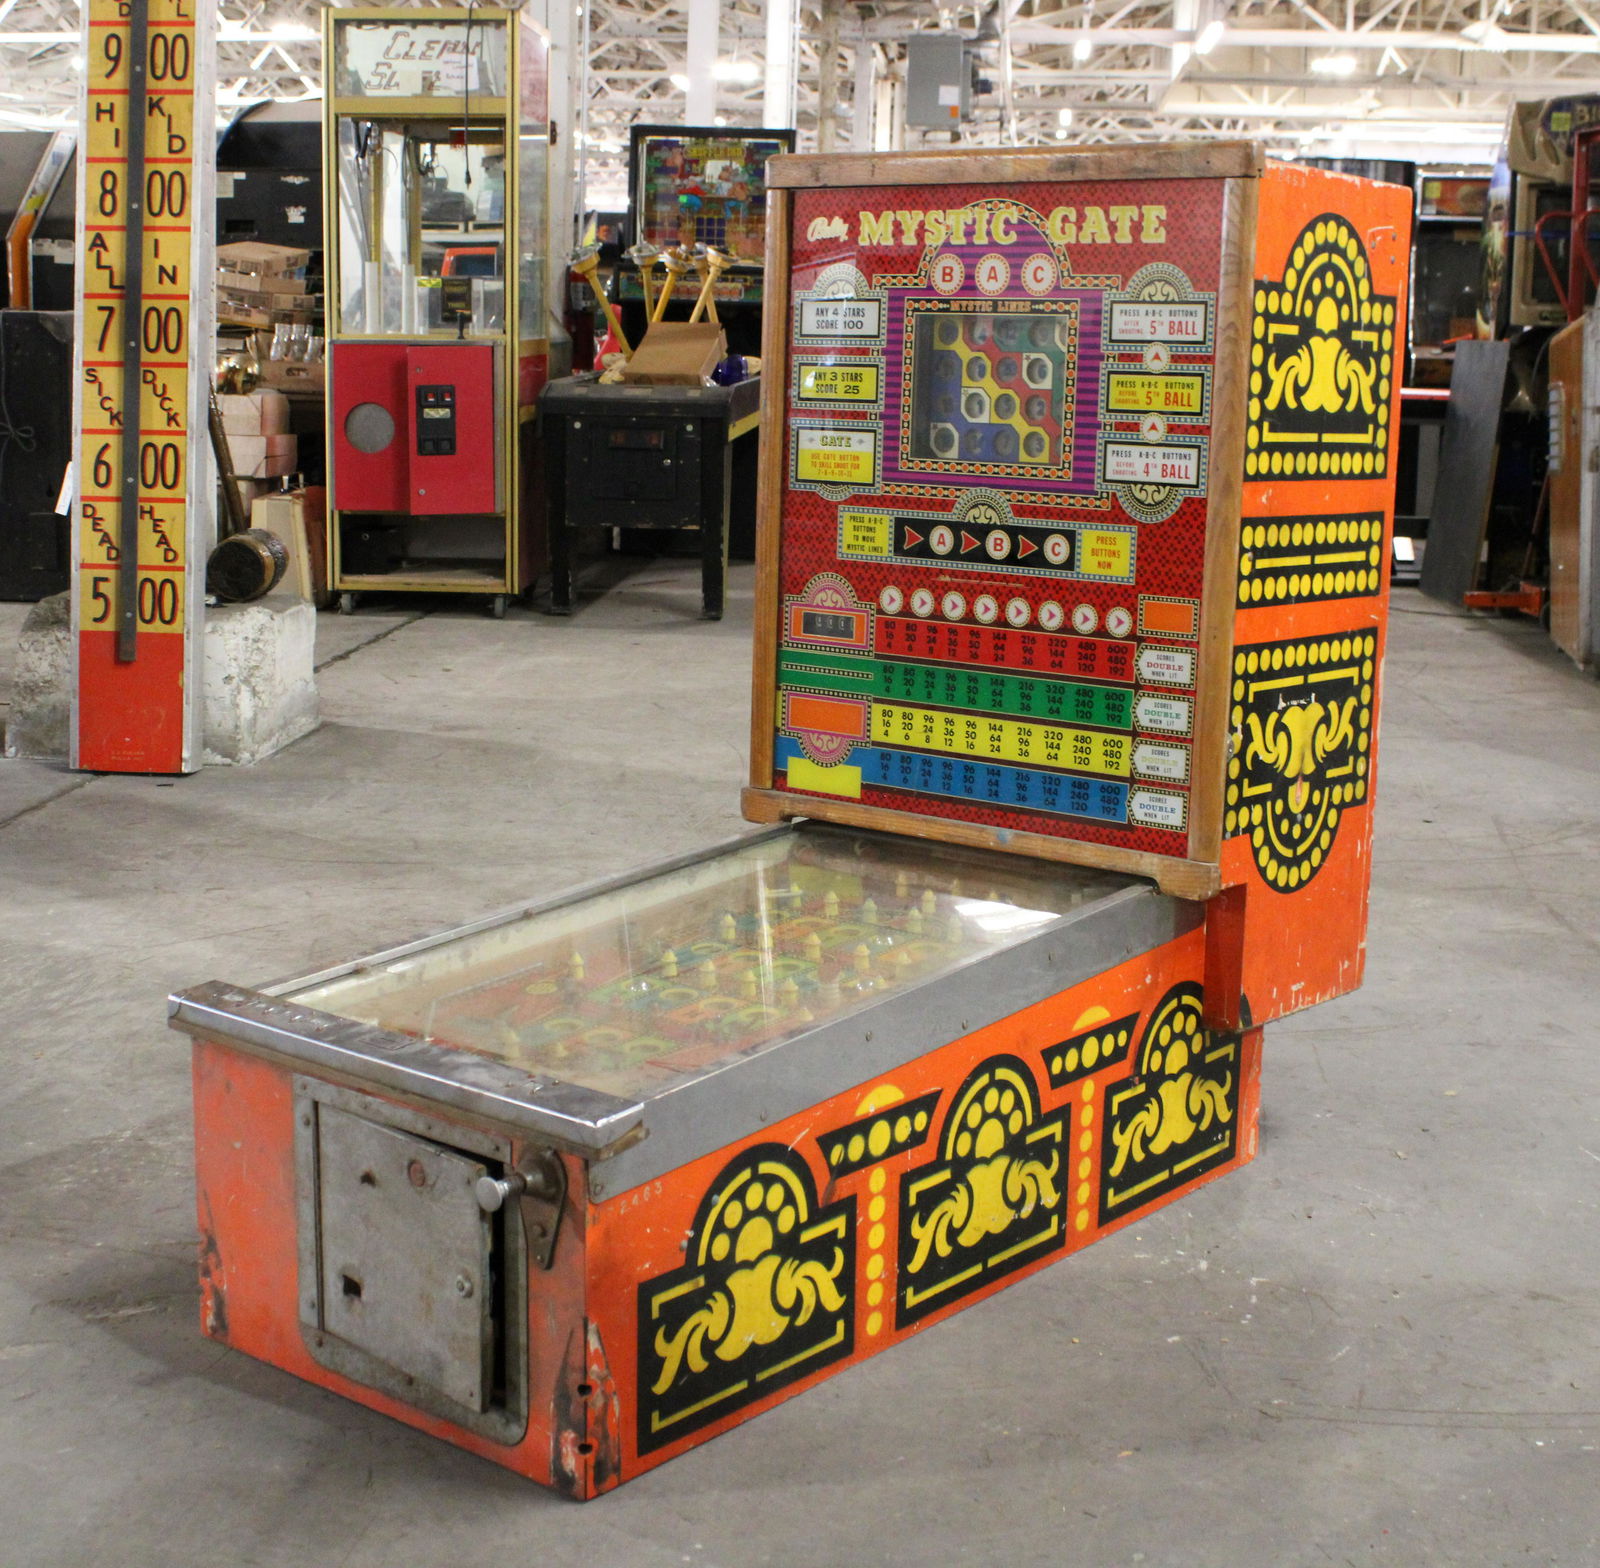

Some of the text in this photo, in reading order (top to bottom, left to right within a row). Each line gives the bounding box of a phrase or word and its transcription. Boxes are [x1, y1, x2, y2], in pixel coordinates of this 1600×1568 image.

[104, 33, 190, 81] 9 00
[95, 96, 187, 155] HI KID
[99, 170, 187, 219] 8 00
[858, 209, 1018, 246] MYSTIC
[1049, 205, 1167, 244] GATE
[88, 232, 179, 290] ALL IN
[941, 265, 1045, 284] B A C
[816, 308, 866, 318] ANY 4 STARS
[951, 301, 1032, 312] MYSTIC LINES
[97, 306, 184, 354] 7 00
[816, 321, 863, 330] SCORE 100
[1169, 321, 1197, 335] BALL
[814, 372, 863, 382] ANY 3 STARS
[816, 384, 860, 394] SCORE 25
[1117, 380, 1136, 389] PRESS
[1165, 382, 1194, 390] BUTTONS
[84, 368, 181, 428] SICK DUCK
[1164, 392, 1192, 407] BALL
[819, 435, 852, 448] GATE
[1112, 450, 1131, 458] PRESS
[1162, 452, 1191, 461] BUTTONS
[93, 442, 180, 491] 6 00
[1161, 464, 1190, 480] BALL
[82, 503, 179, 564] DEAD HEAD
[853, 525, 876, 534] BUTTONS
[936, 533, 1061, 556] A B C
[1096, 536, 1117, 545] PRESS
[1091, 548, 1120, 558] BUTTONS
[1097, 560, 1112, 569] NOW
[91, 577, 179, 625] 5 00
[1156, 654, 1174, 662] SCORES
[1147, 661, 1184, 672] DOUBLE
[1144, 709, 1181, 720] DOUBLE
[882, 709, 1123, 748] 80 80 96 96 96 144 216 320 480 600
[883, 719, 1121, 759] 16 20 24 36 50 64 96 144 240 480
[925, 735, 930, 743] 8
[945, 738, 952, 746] 12
[966, 741, 975, 750] 16
[990, 744, 1000, 752] 24
[1018, 748, 1029, 757] 36
[1074, 756, 1090, 765] 120
[1105, 760, 1119, 770] 192
[1151, 749, 1169, 757] SCORES
[1149, 796, 1167, 804] SCORES
[1139, 803, 1176, 814] DOUBLE
[1144, 812, 1157, 820] WHEN
